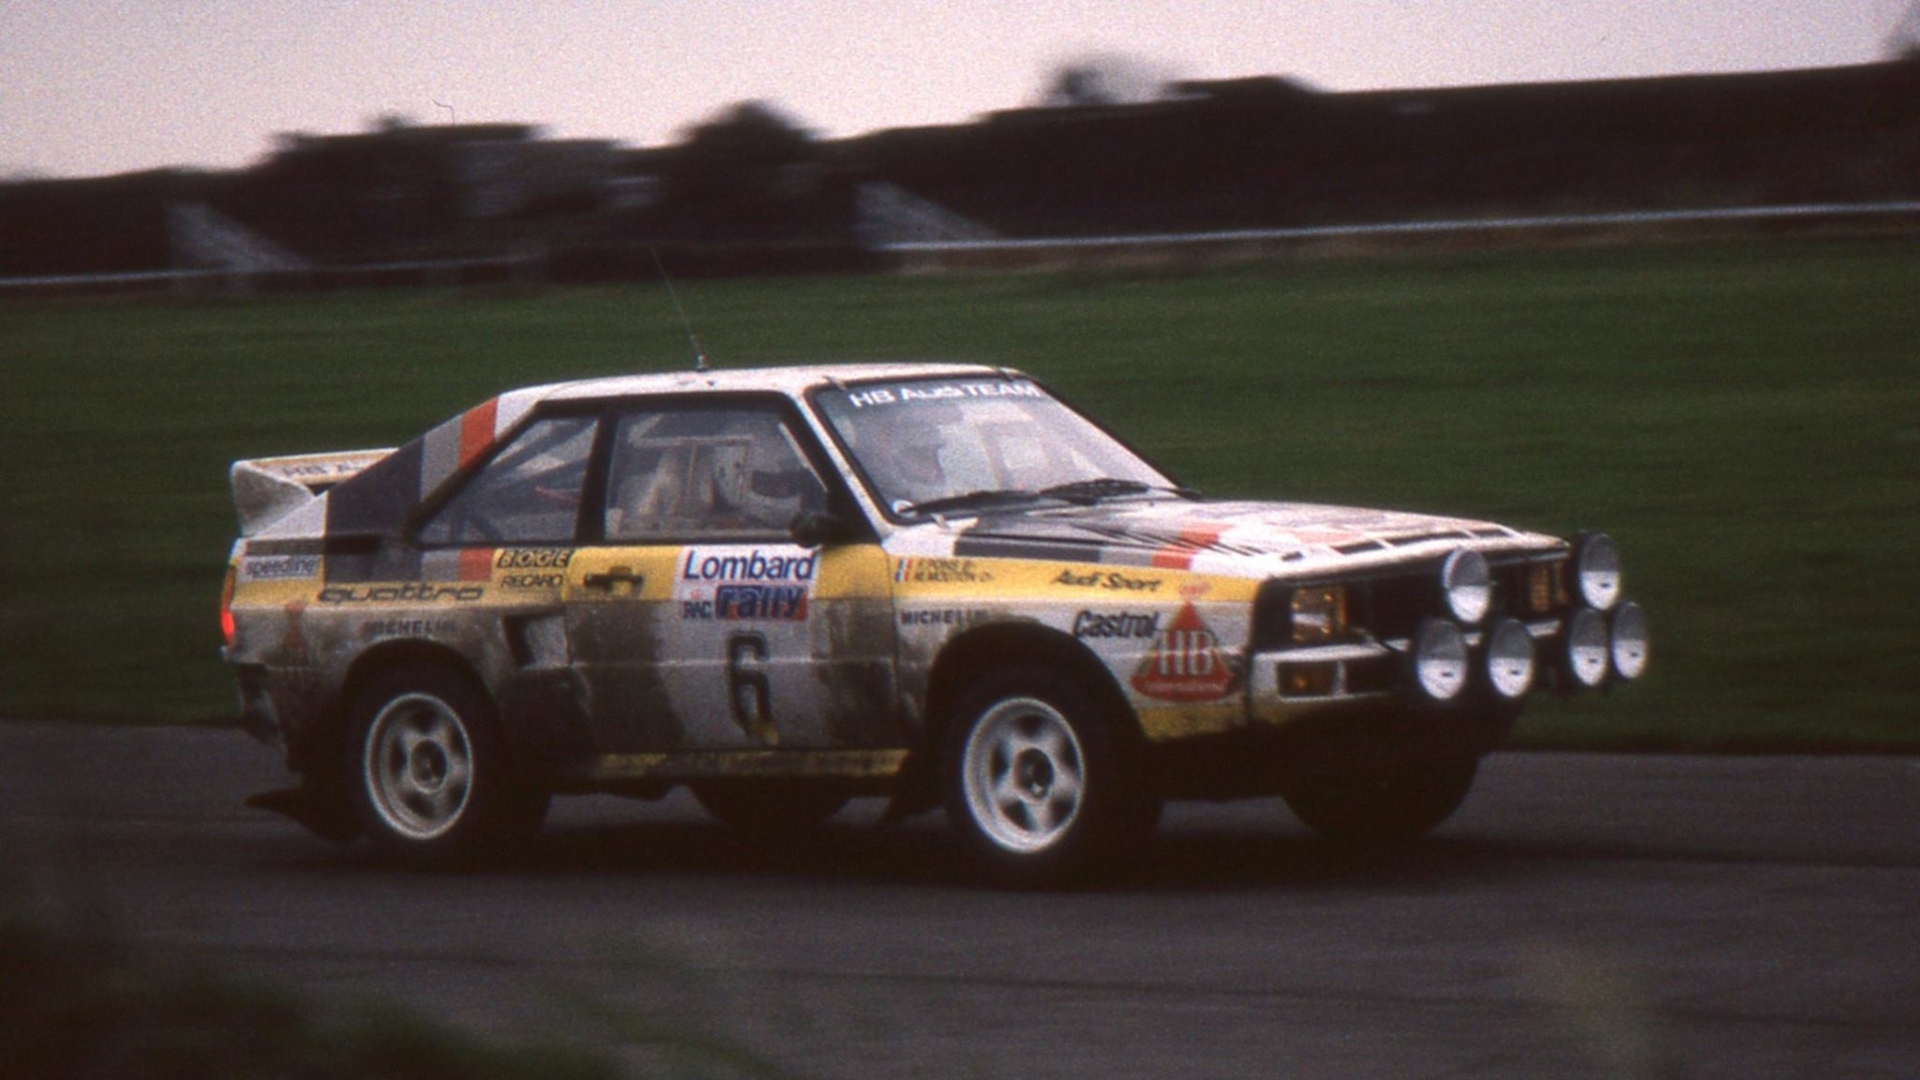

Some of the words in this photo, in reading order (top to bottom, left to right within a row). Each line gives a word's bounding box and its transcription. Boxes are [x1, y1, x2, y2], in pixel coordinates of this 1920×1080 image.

[849, 389, 896, 408] HB
[962, 383, 1041, 398] TEAM
[683, 550, 817, 580] Lombard
[501, 573, 563, 588] RECARO
[1050, 570, 1103, 586] Audi
[1101, 572, 1162, 592] Sport
[318, 583, 483, 605] quattro
[717, 585, 808, 620] rally
[683, 600, 711, 618] RAC
[1074, 610, 1159, 638] Castrol
[1157, 629, 1216, 676] HB
[728, 632, 776, 741] 6
